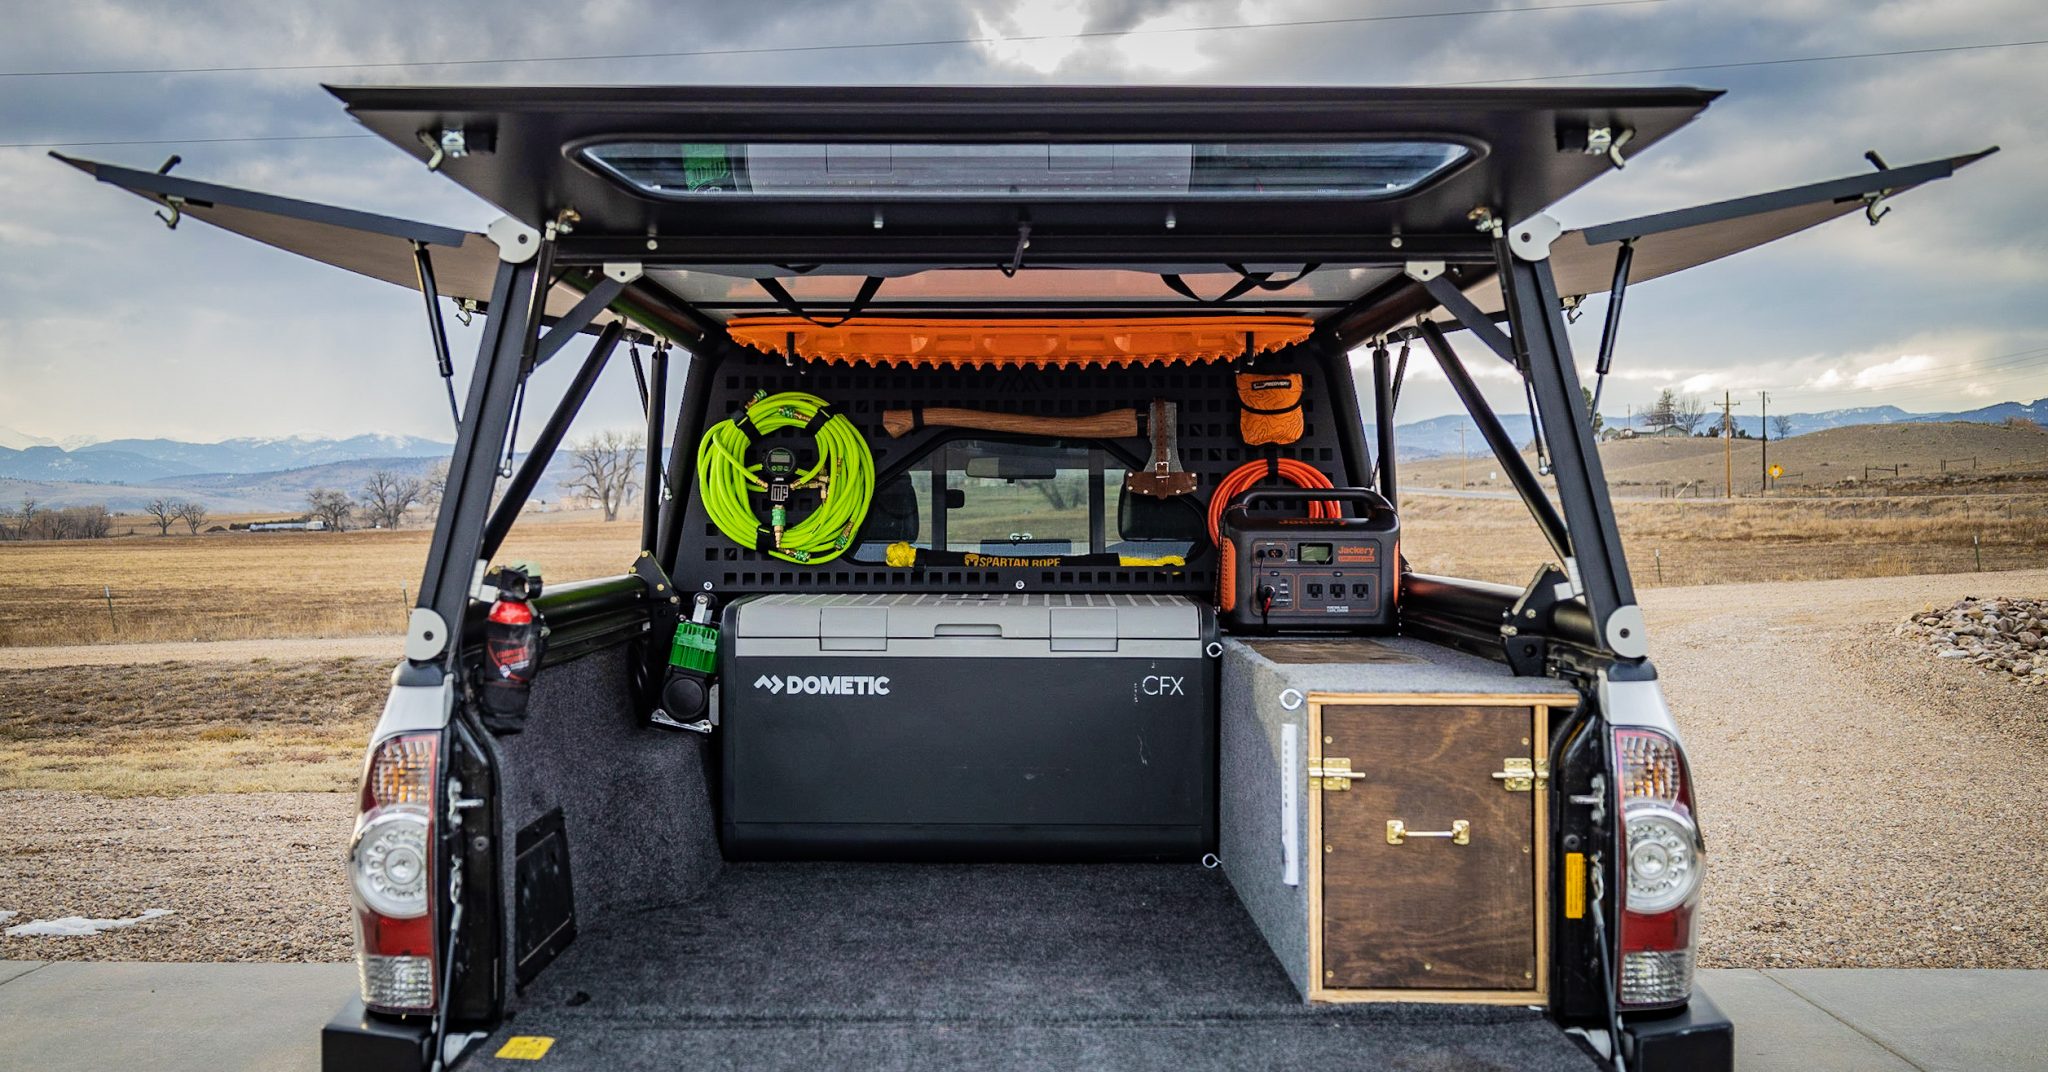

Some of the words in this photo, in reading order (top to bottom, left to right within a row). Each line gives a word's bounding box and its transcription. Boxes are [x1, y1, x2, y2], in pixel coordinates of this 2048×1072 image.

[1337, 546, 1375, 556] Jackery
[979, 556, 1029, 568] SPARTAN
[1031, 557, 1061, 568] ROPE
[786, 675, 891, 696] DOMETIC
[1142, 675, 1185, 696] CFX
